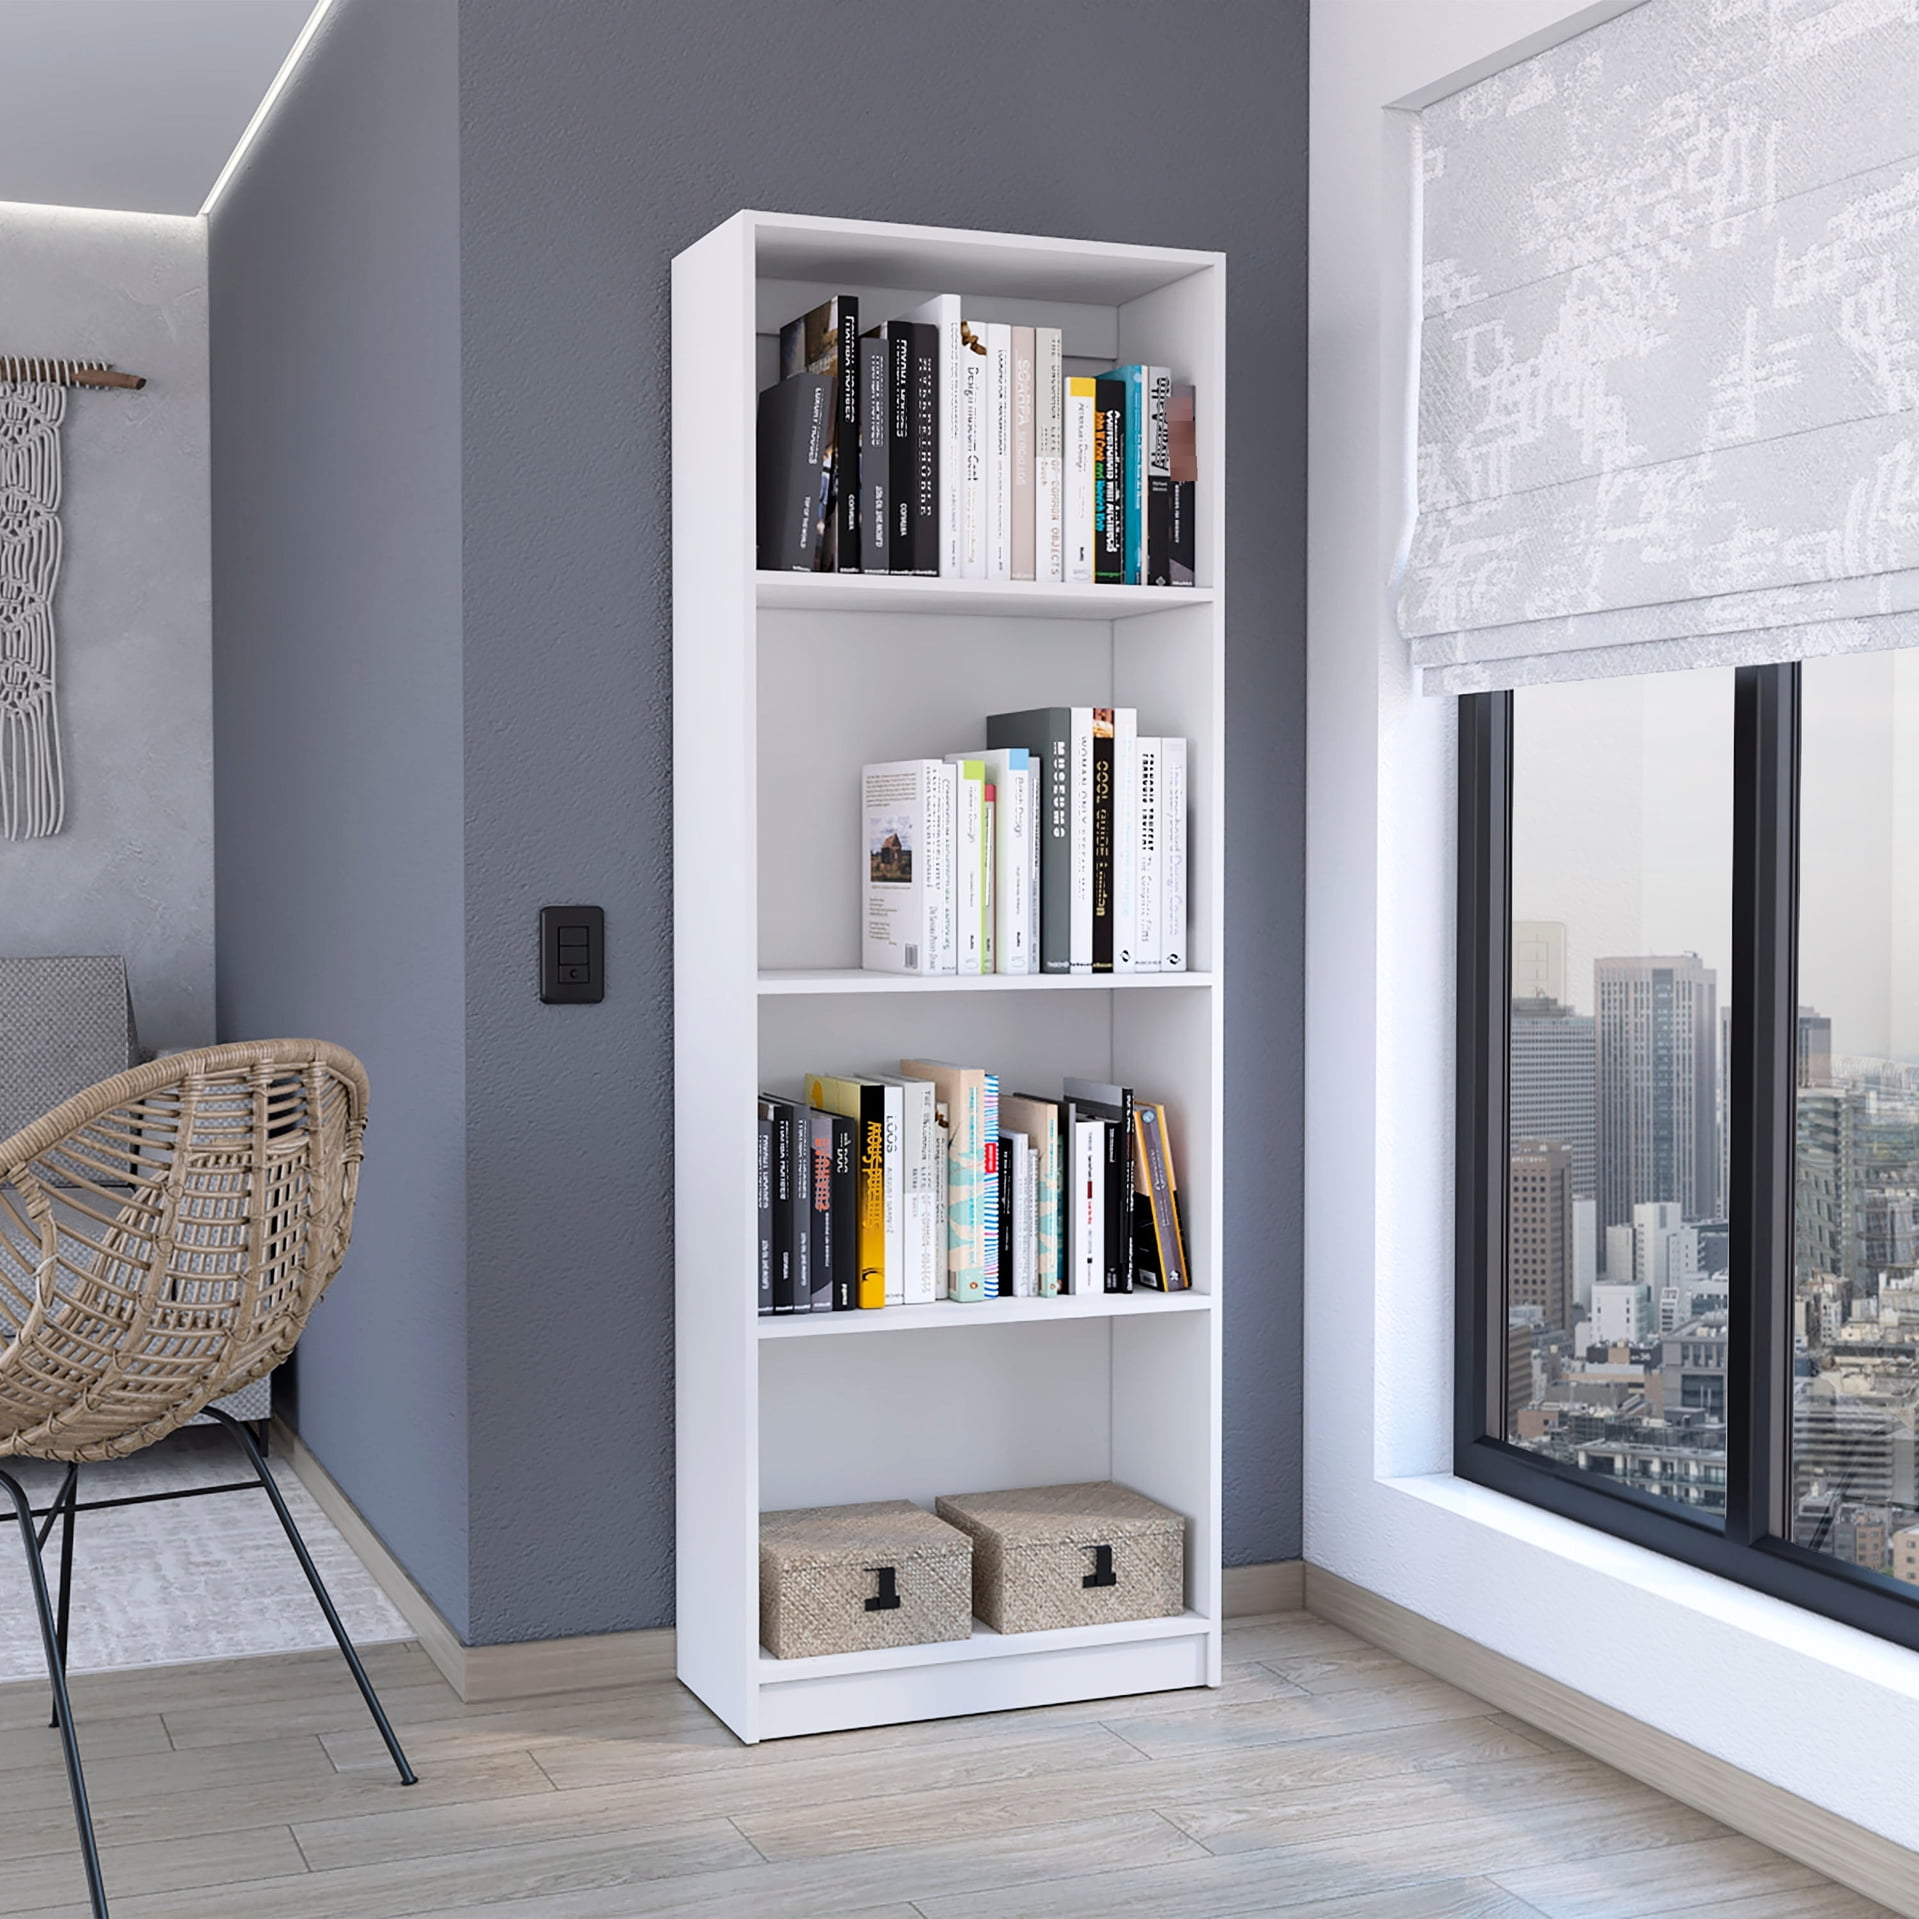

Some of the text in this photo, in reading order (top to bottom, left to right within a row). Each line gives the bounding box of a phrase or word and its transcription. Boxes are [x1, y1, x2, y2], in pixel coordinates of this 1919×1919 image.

[1106, 410, 1121, 479] Conversations
[1051, 528, 1060, 575] OBJECTS
[1096, 761, 1109, 803] COOL
[886, 1115, 898, 1153] LOOS
